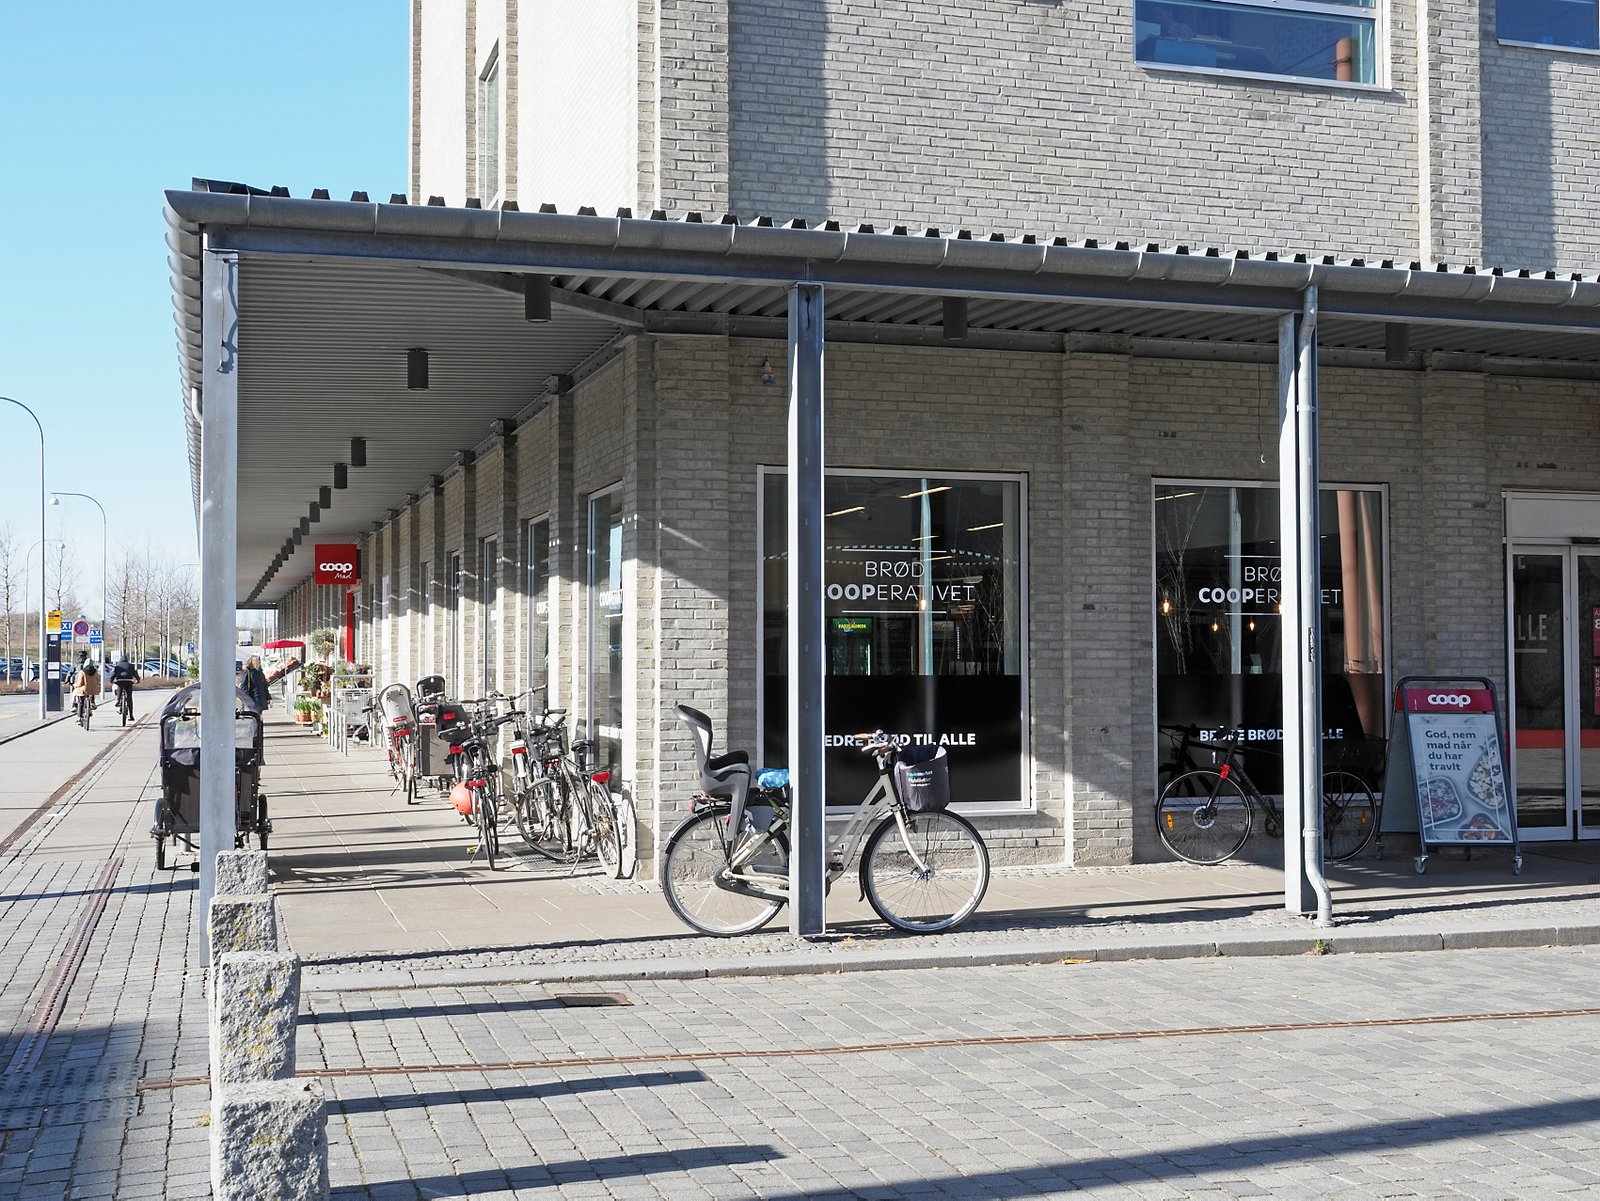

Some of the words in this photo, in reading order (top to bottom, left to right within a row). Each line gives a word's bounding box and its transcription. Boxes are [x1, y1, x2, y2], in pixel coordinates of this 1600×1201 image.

[319, 562, 353, 573] coop
[866, 561, 925, 578] BRØD
[334, 571, 353, 579] Mad
[1244, 566, 1281, 582] BRØ
[825, 583, 975, 601] OOPERATIVET
[1198, 587, 1342, 604] COOPERET
[62, 622, 72, 630] XI
[1517, 614, 1547, 641] LLE
[1427, 694, 1471, 708] coop
[825, 734, 864, 747] EDRE
[867, 733, 911, 747] BØD
[913, 733, 936, 746] TIL
[939, 733, 976, 746] ALLE
[1425, 730, 1450, 740] God,
[1452, 731, 1477, 739] nem
[1427, 741, 1451, 750] mad
[1453, 740, 1472, 750] når
[1428, 751, 1442, 760] du
[1444, 751, 1463, 760] har
[1429, 762, 1461, 771] travlt
